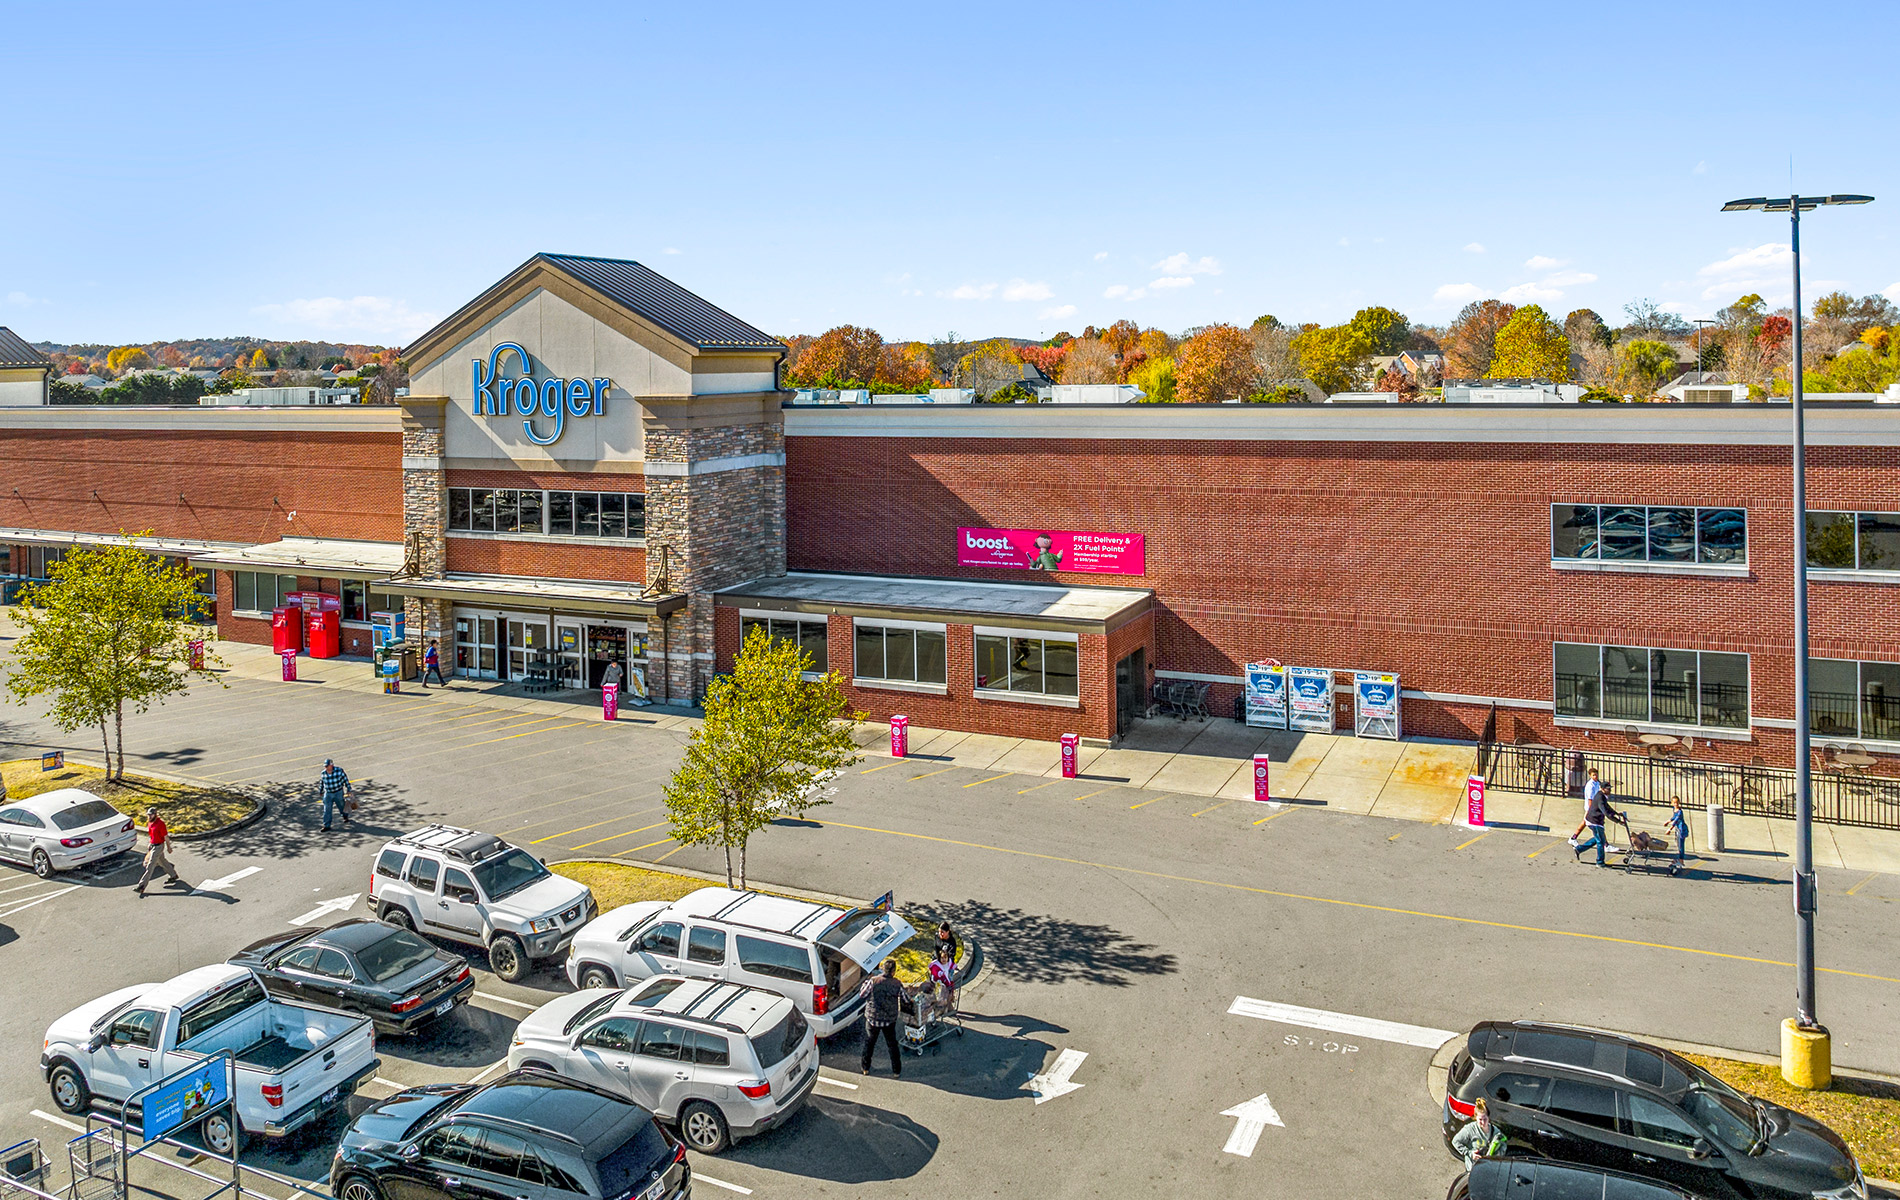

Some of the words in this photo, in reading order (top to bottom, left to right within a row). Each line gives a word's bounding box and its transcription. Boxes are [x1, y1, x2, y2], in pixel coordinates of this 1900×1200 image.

[472, 341, 610, 446] Kroger
[966, 531, 1008, 550] boost
[1073, 535, 1093, 543] FREE
[1094, 536, 1123, 545] Delivery
[1084, 544, 1100, 552] Fuel
[1283, 1034, 1360, 1054] STOP
